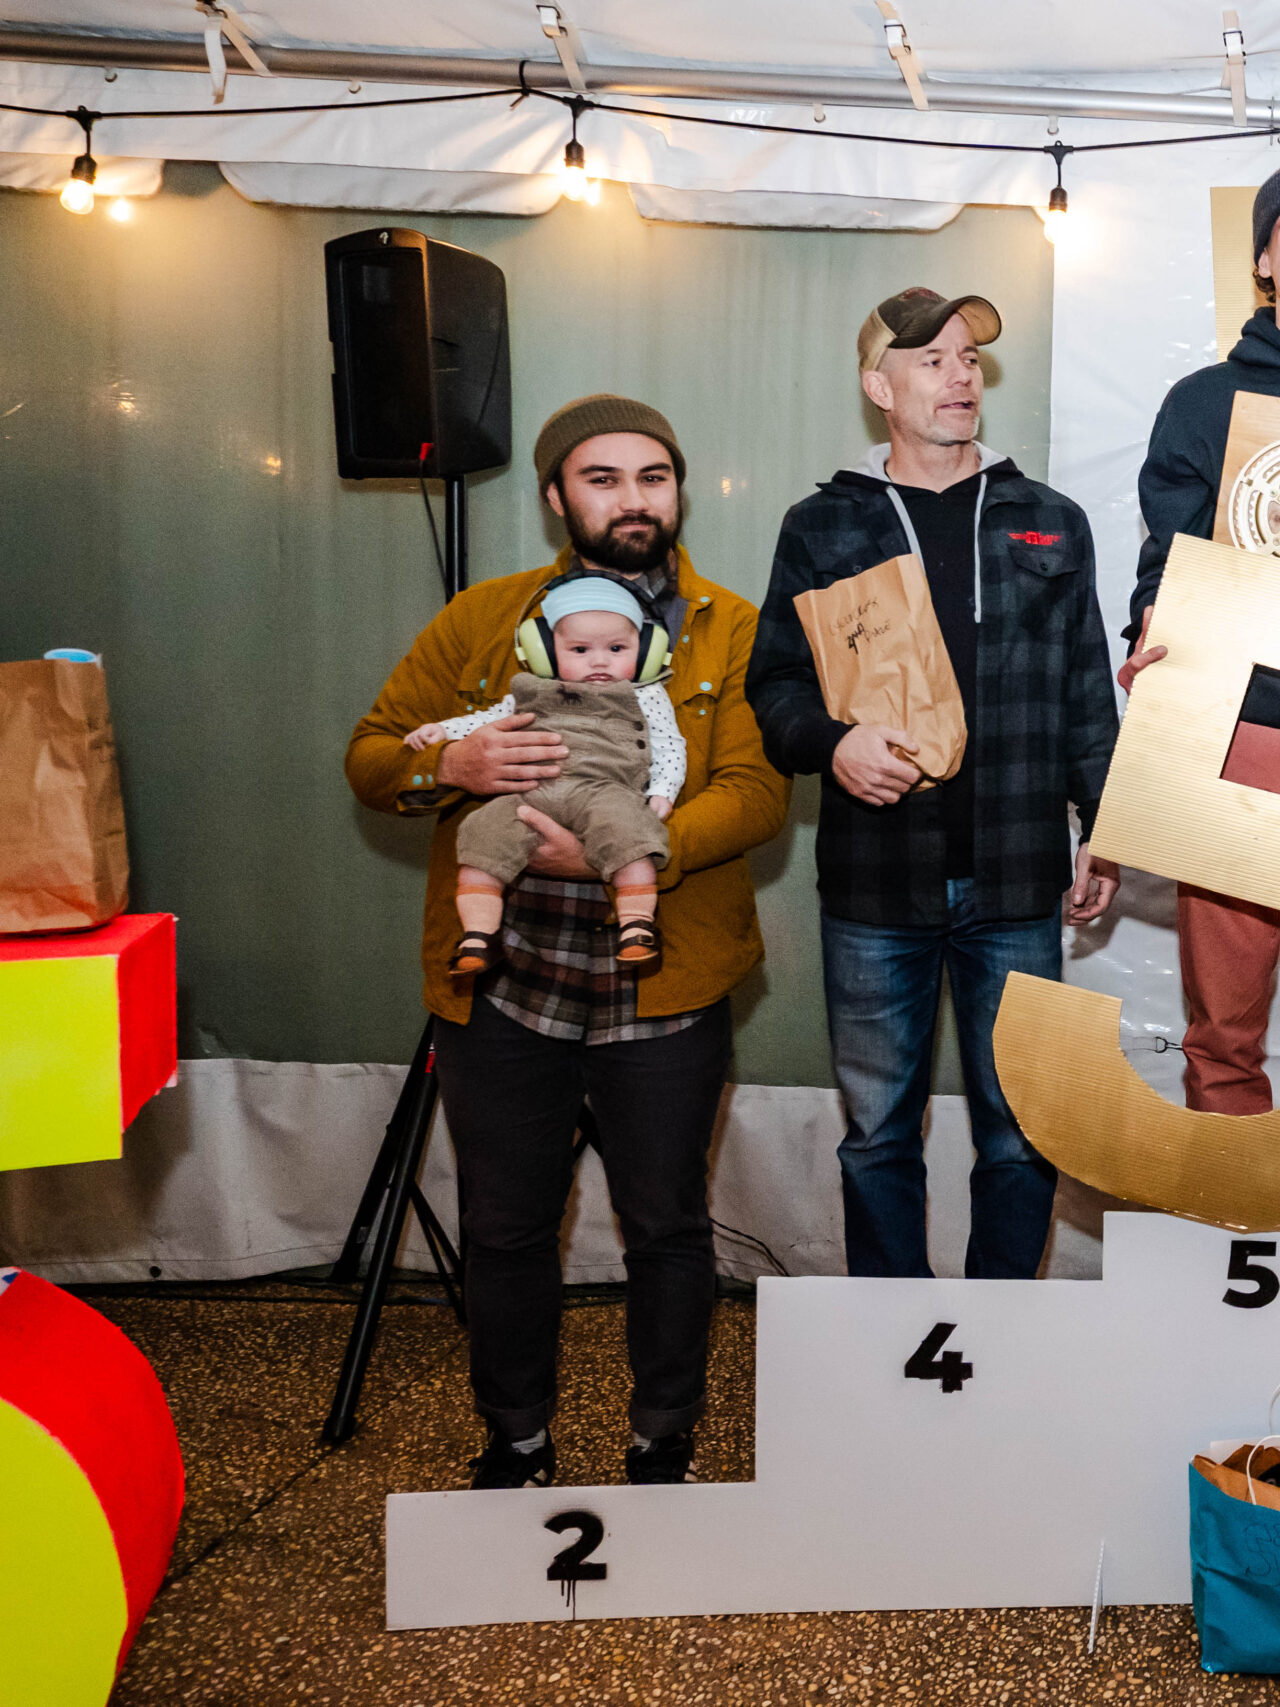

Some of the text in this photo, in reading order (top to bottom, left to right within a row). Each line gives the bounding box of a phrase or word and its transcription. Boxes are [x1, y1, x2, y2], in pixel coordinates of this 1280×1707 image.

[1222, 1240, 1280, 1309] 5
[904, 1321, 974, 1394] 4
[543, 1509, 607, 1582] 2
